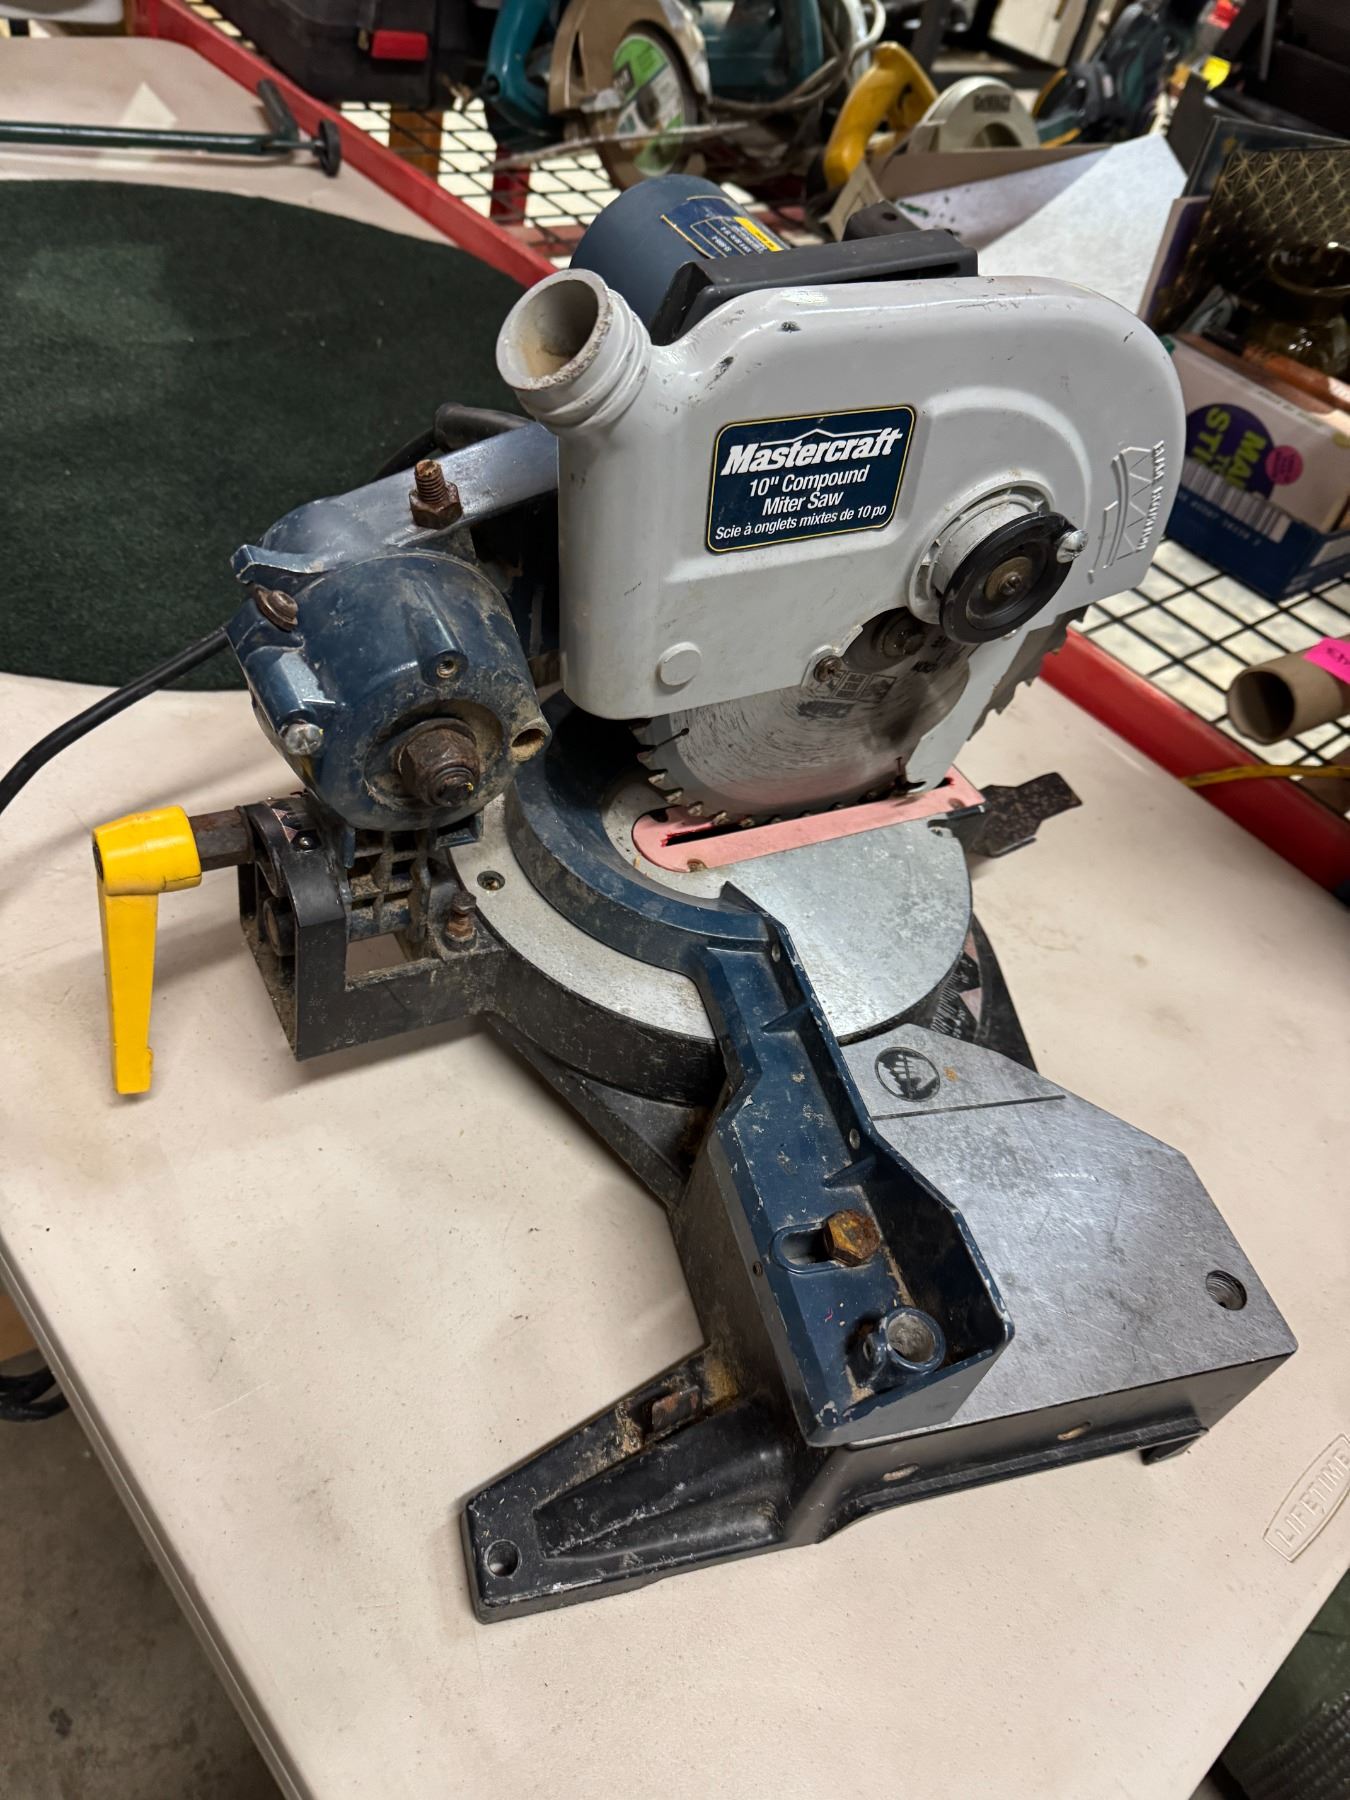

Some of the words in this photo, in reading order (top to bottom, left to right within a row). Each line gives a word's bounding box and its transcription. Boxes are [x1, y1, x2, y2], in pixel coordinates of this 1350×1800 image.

[720, 427, 903, 476] Mastercraft
[750, 477, 779, 497] 10"
[782, 464, 870, 493] Compound
[762, 497, 807, 517] Miter
[807, 491, 844, 508] Saw
[715, 525, 741, 540] Scie
[743, 522, 752, 536] à
[754, 516, 797, 534] onglets
[799, 512, 837, 527] mixtes
[839, 507, 854, 521] de
[857, 505, 870, 519] 10
[871, 505, 887, 521] po
[1276, 1446, 1350, 1547] LIFETIME
